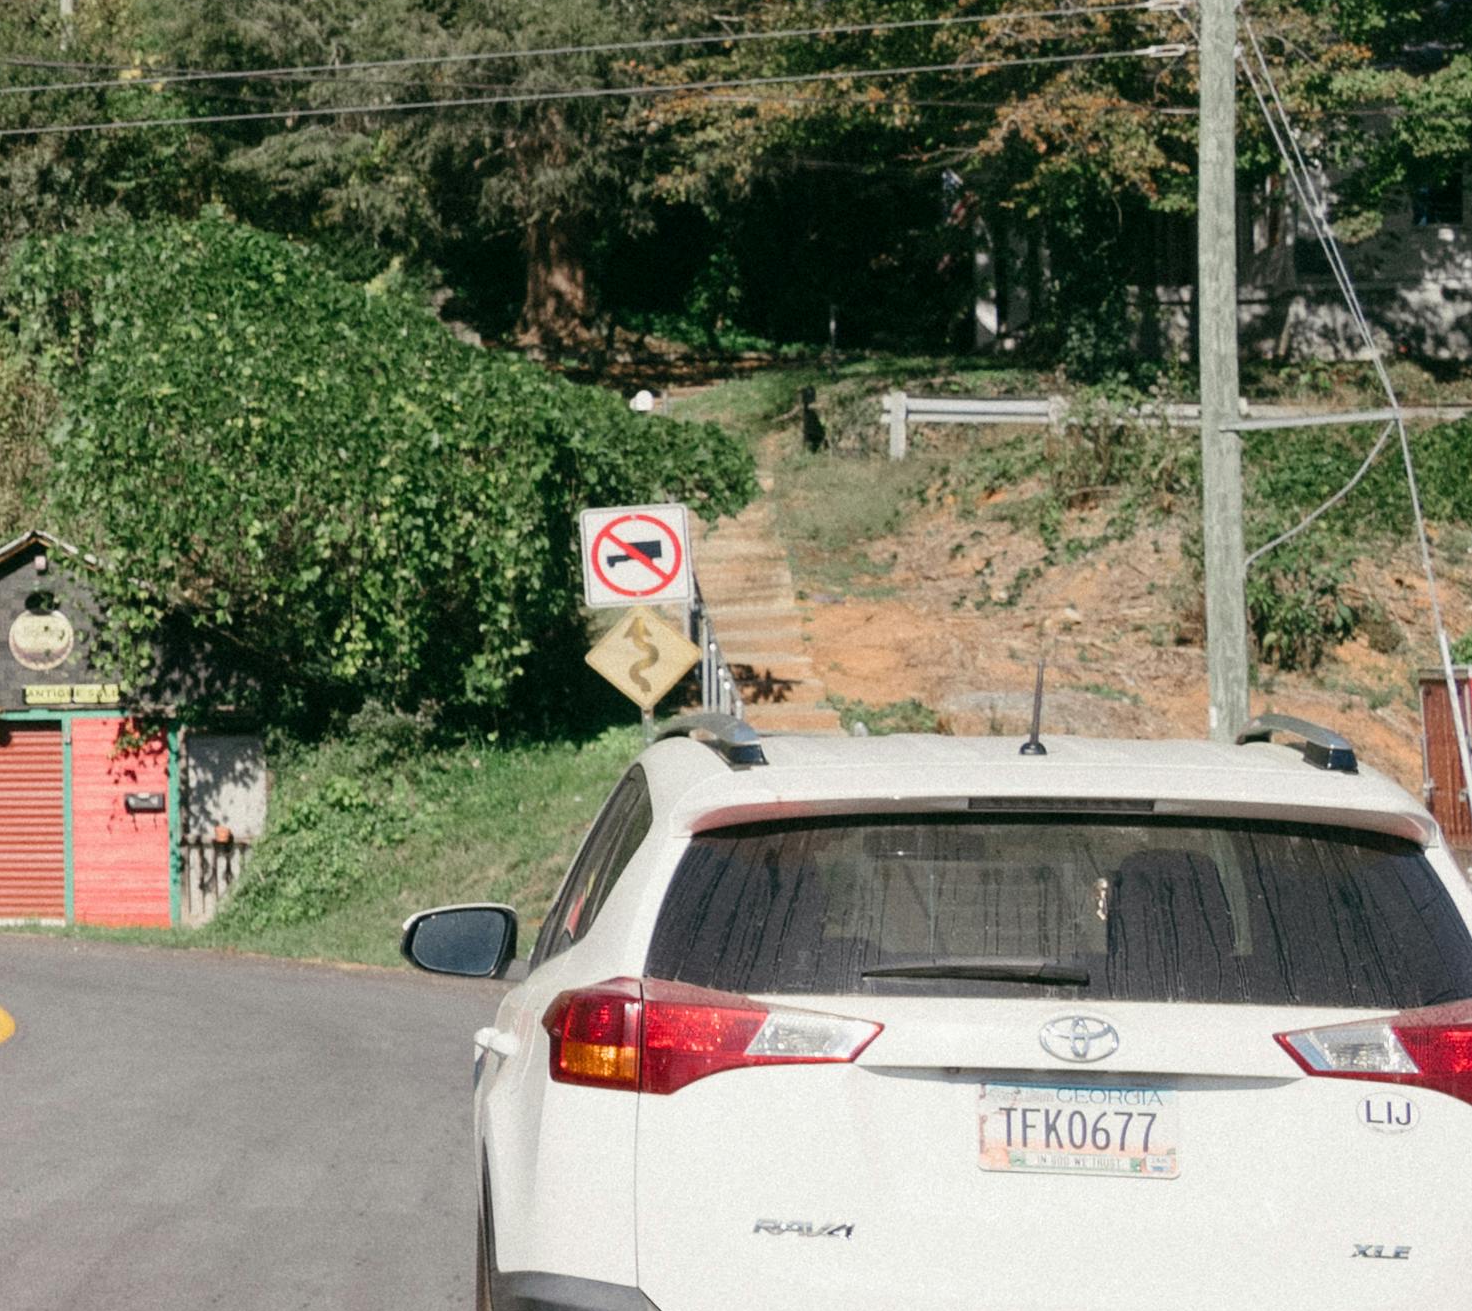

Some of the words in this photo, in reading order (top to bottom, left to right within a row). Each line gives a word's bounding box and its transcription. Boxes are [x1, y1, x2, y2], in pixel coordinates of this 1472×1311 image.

[26, 688, 81, 698] ANTIQE
[1056, 1087, 1164, 1106] GEORGIA
[1365, 1100, 1411, 1125] LIJ
[999, 1107, 1157, 1152] TFK0677
[1037, 1155, 1047, 1164] IN
[753, 1218, 855, 1240] RAV4
[1351, 1243, 1412, 1260] XLE
